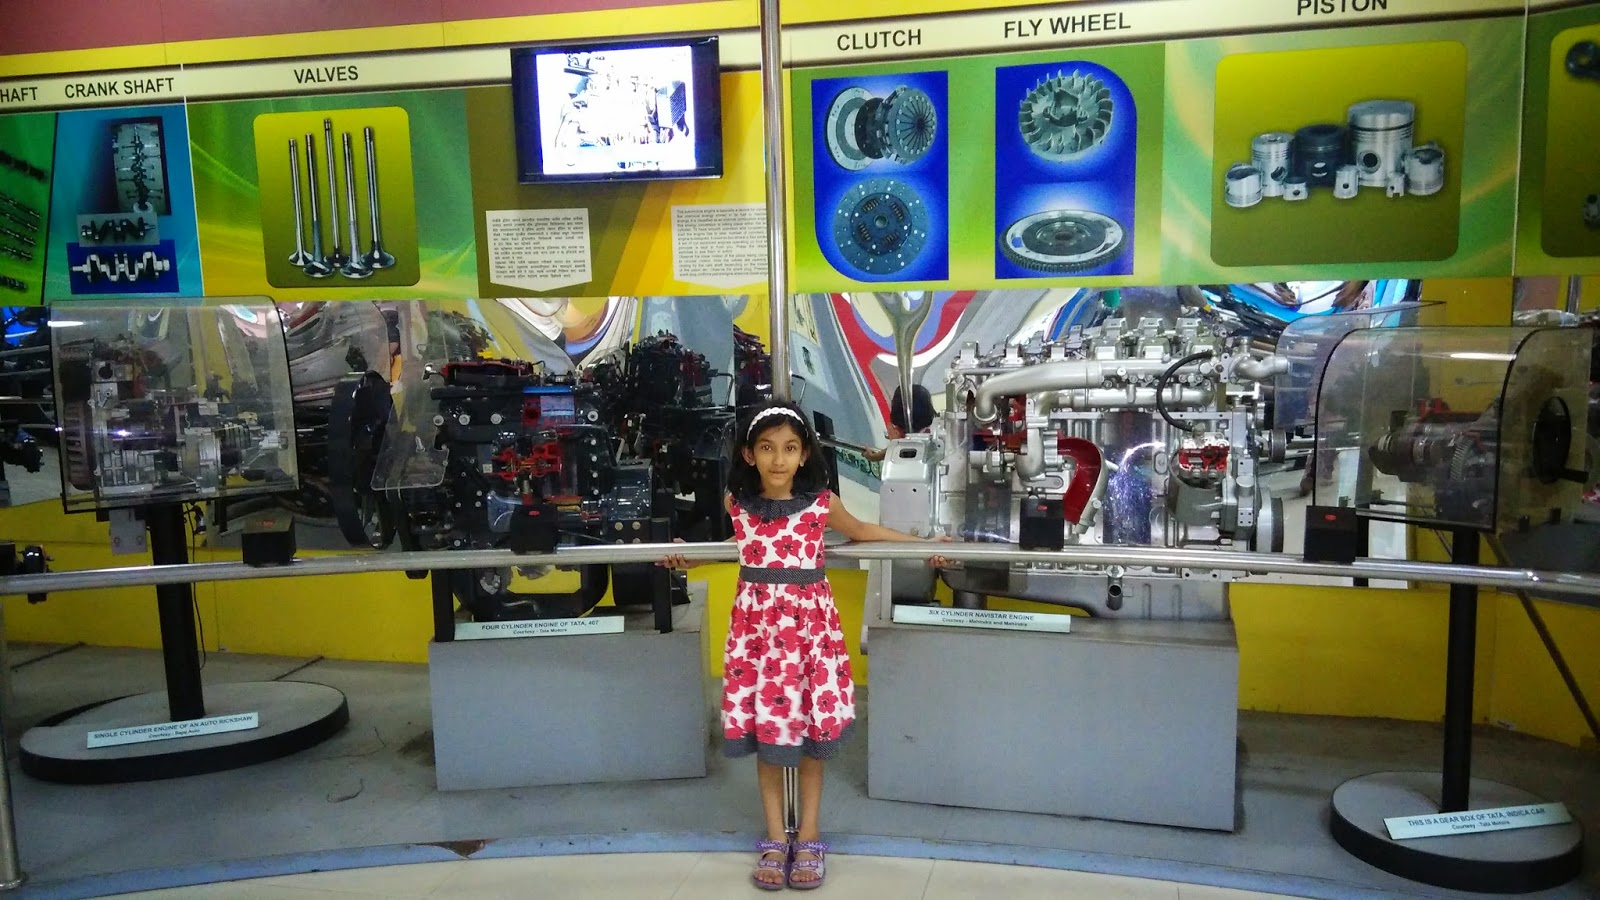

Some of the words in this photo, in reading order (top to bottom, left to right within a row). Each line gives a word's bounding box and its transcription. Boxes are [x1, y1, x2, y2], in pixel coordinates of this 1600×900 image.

[1297, 0, 1387, 16] PISTON
[1004, 19, 1042, 39] FLY
[1049, 12, 1132, 35] WHEEL
[836, 28, 922, 51] CLUTCH
[293, 65, 359, 84] VALVES
[64, 81, 119, 99] CRANK
[123, 77, 175, 95] SHAFT
[94, 731, 118, 739] SINGLE
[120, 728, 152, 736] CYLINDER
[154, 724, 178, 732] ENGINE
[218, 716, 252, 724] RICKSHAW
[1506, 809, 1530, 817] INDICA
